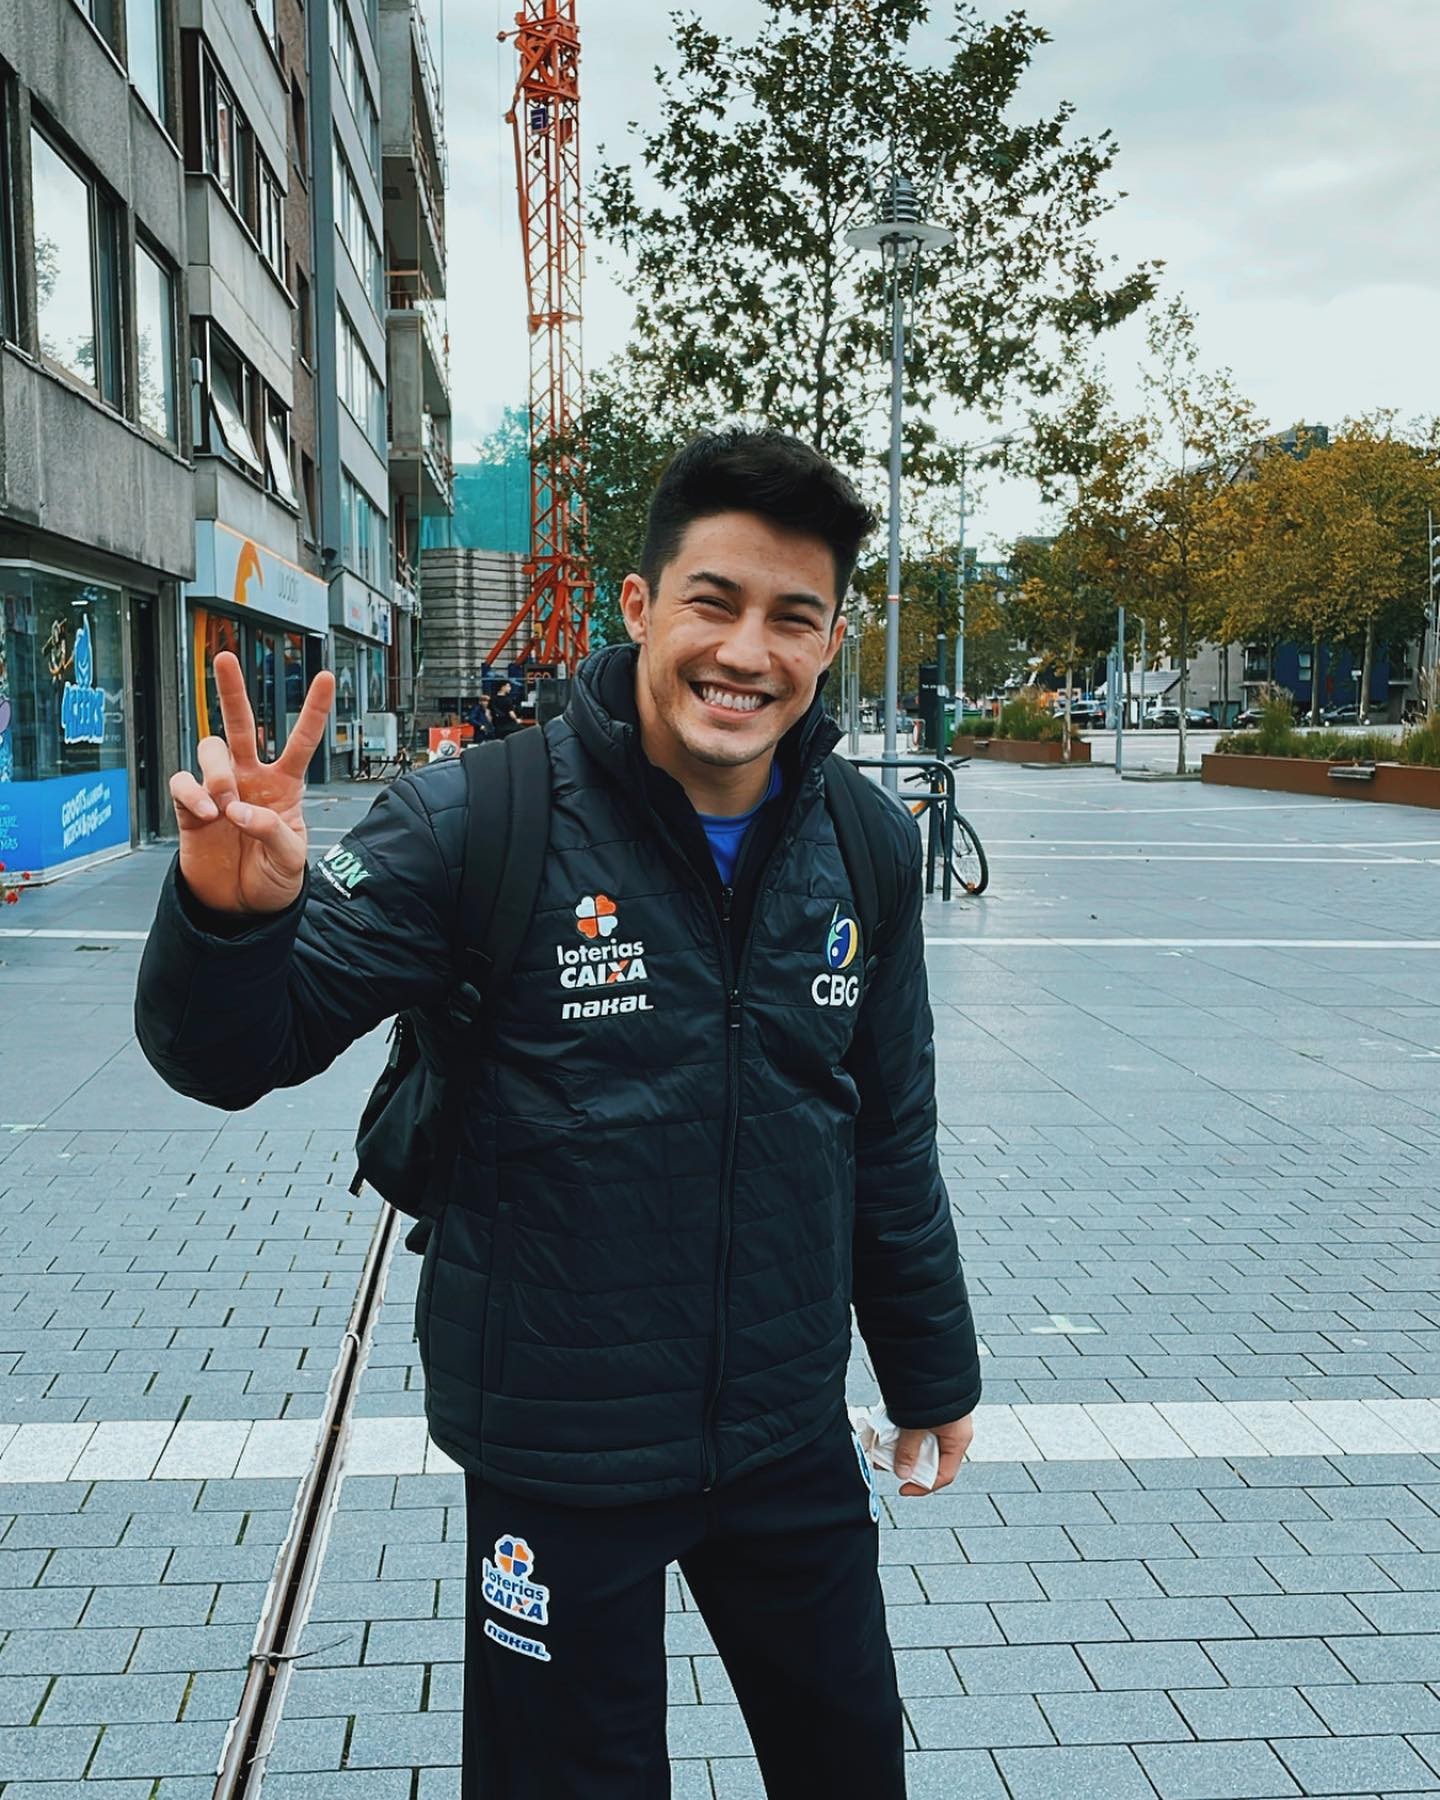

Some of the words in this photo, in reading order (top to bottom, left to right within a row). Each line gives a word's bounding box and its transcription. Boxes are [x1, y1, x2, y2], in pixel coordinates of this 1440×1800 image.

[557, 938, 645, 965] loterias
[560, 959, 648, 989] CAIXA
[811, 973, 859, 1007] CBG
[484, 1563, 544, 1601] loterias
[484, 1583, 544, 1621] CAIXA
